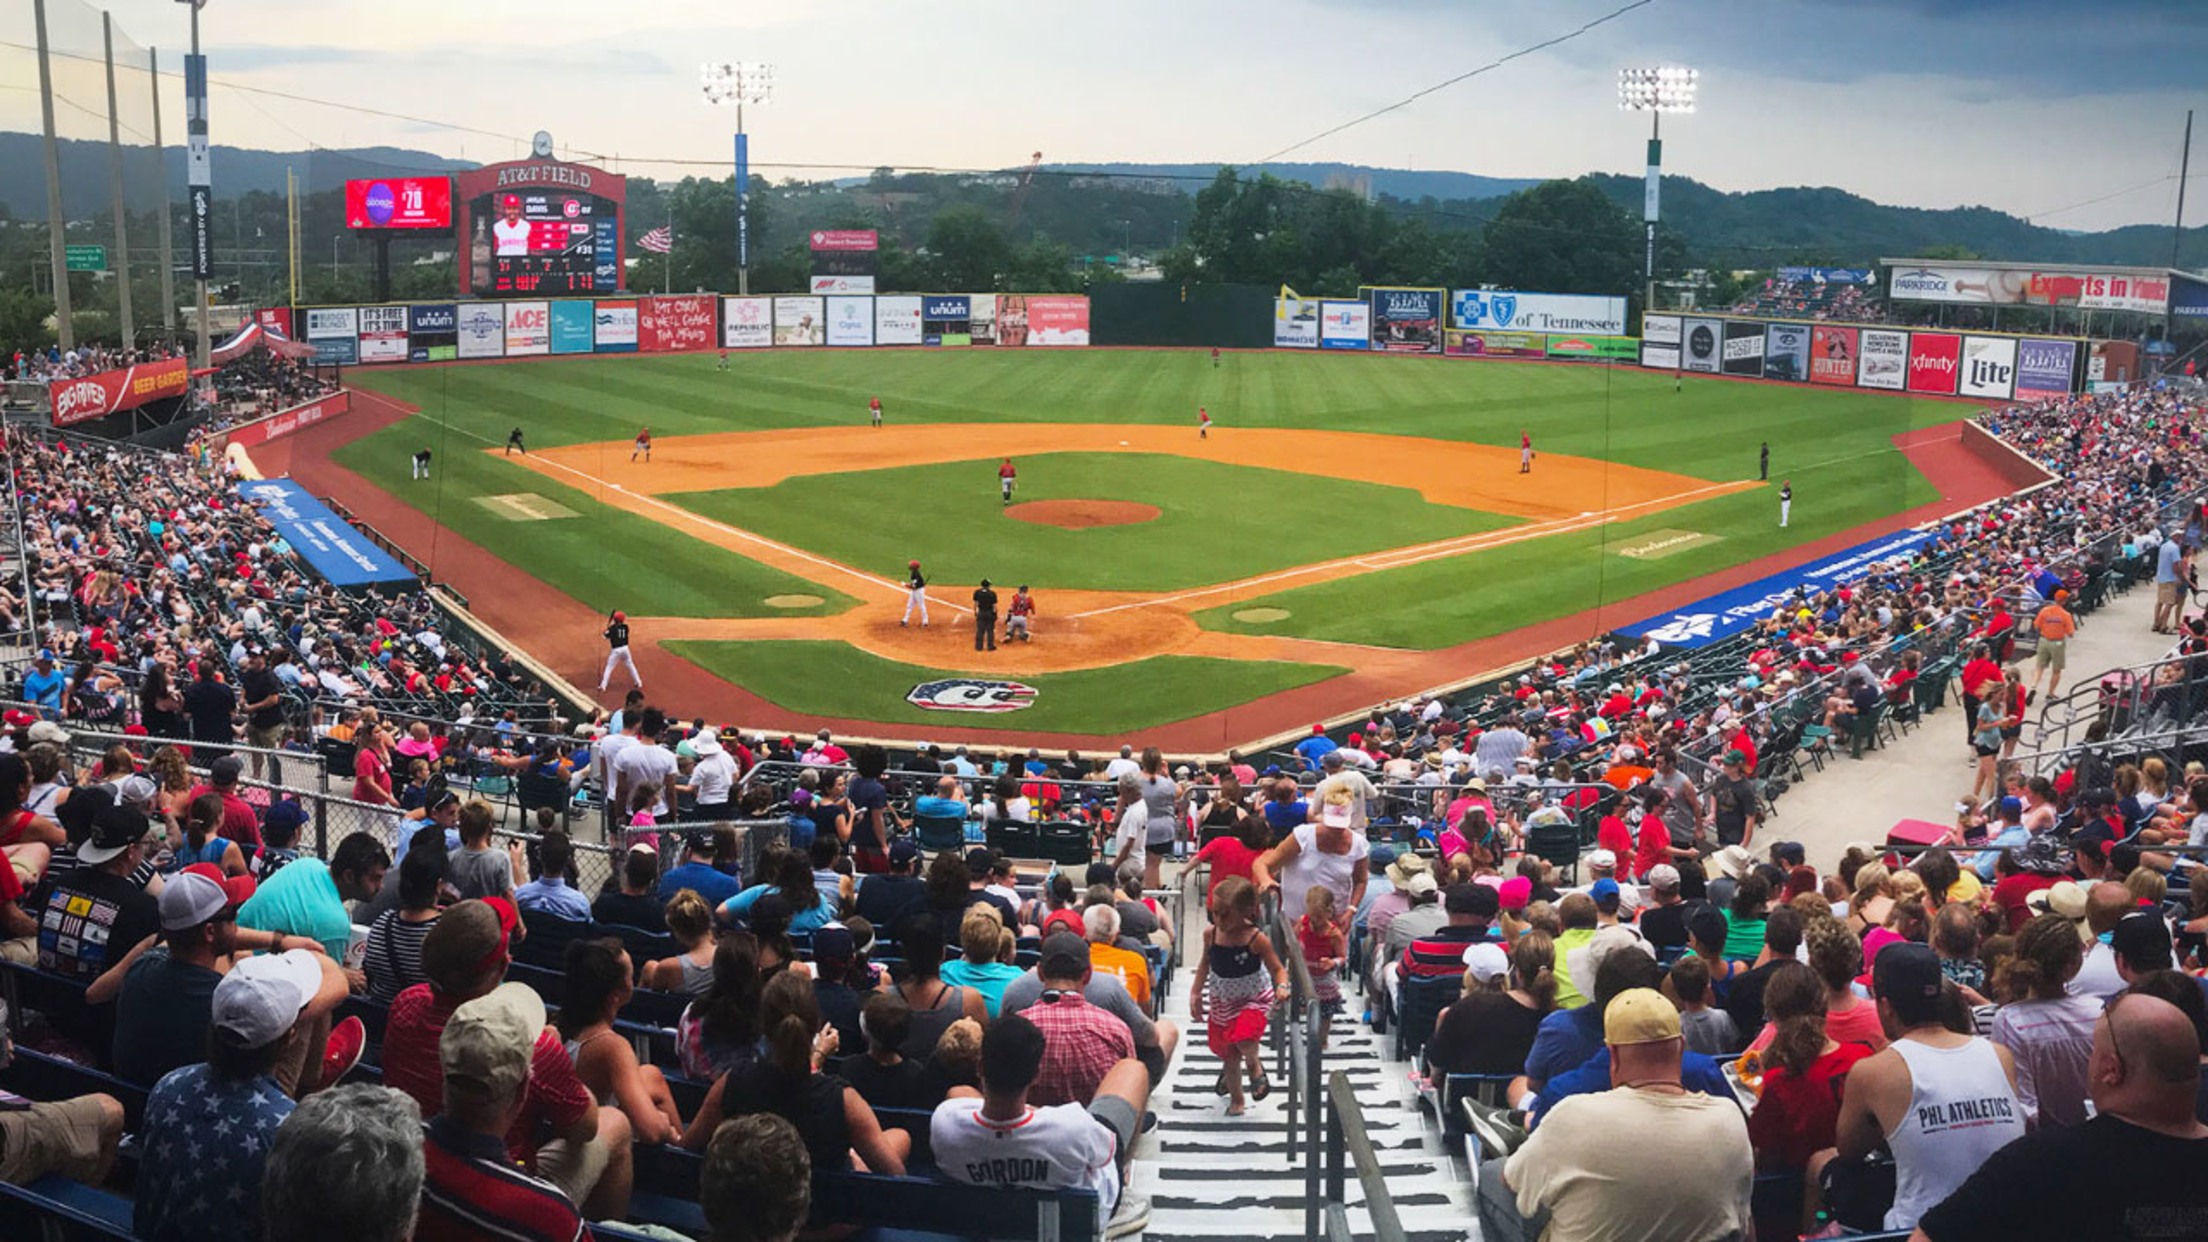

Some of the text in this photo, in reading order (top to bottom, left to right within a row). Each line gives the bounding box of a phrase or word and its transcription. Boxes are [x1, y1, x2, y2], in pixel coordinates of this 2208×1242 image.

[498, 165, 591, 188] AT&T FIELD
[1895, 278, 1947, 292] PARKRIDGE
[2109, 276, 2127, 297] in
[364, 308, 402, 319] IT'S FREE
[509, 309, 546, 329] ACE
[1515, 313, 1621, 331] of Tennessee
[364, 320, 403, 330] IT'S TIME
[728, 323, 770, 331] REPUBLIC
[1911, 353, 1956, 374] xfinity
[1970, 359, 2010, 389] Lite
[134, 370, 187, 395] BEER GARDEN
[58, 386, 76, 416] BIG
[76, 382, 107, 408] RIVER
[618, 628, 626, 638] 11
[1918, 1097, 2013, 1128] PHL ATHLETICS
[966, 1157, 1050, 1183] GORDON
